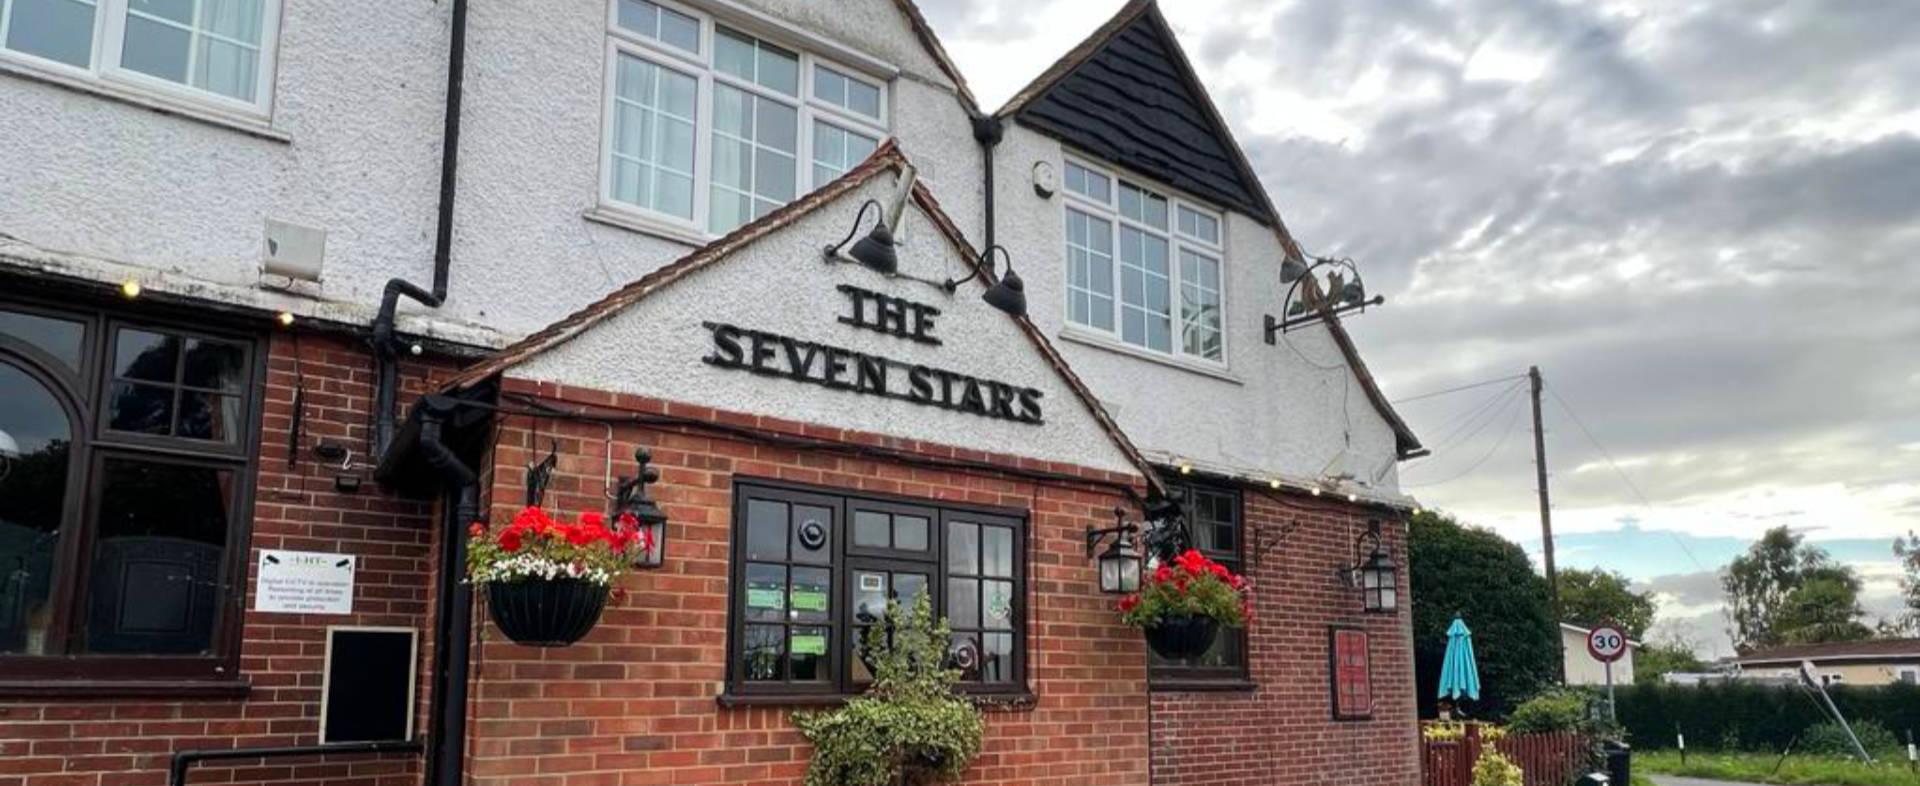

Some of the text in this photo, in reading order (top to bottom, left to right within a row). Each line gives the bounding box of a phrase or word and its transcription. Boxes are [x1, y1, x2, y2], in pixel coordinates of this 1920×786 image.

[838, 284, 942, 346] THE
[704, 321, 1043, 425] SEVEN STARS
[1594, 635, 1620, 650] 30
